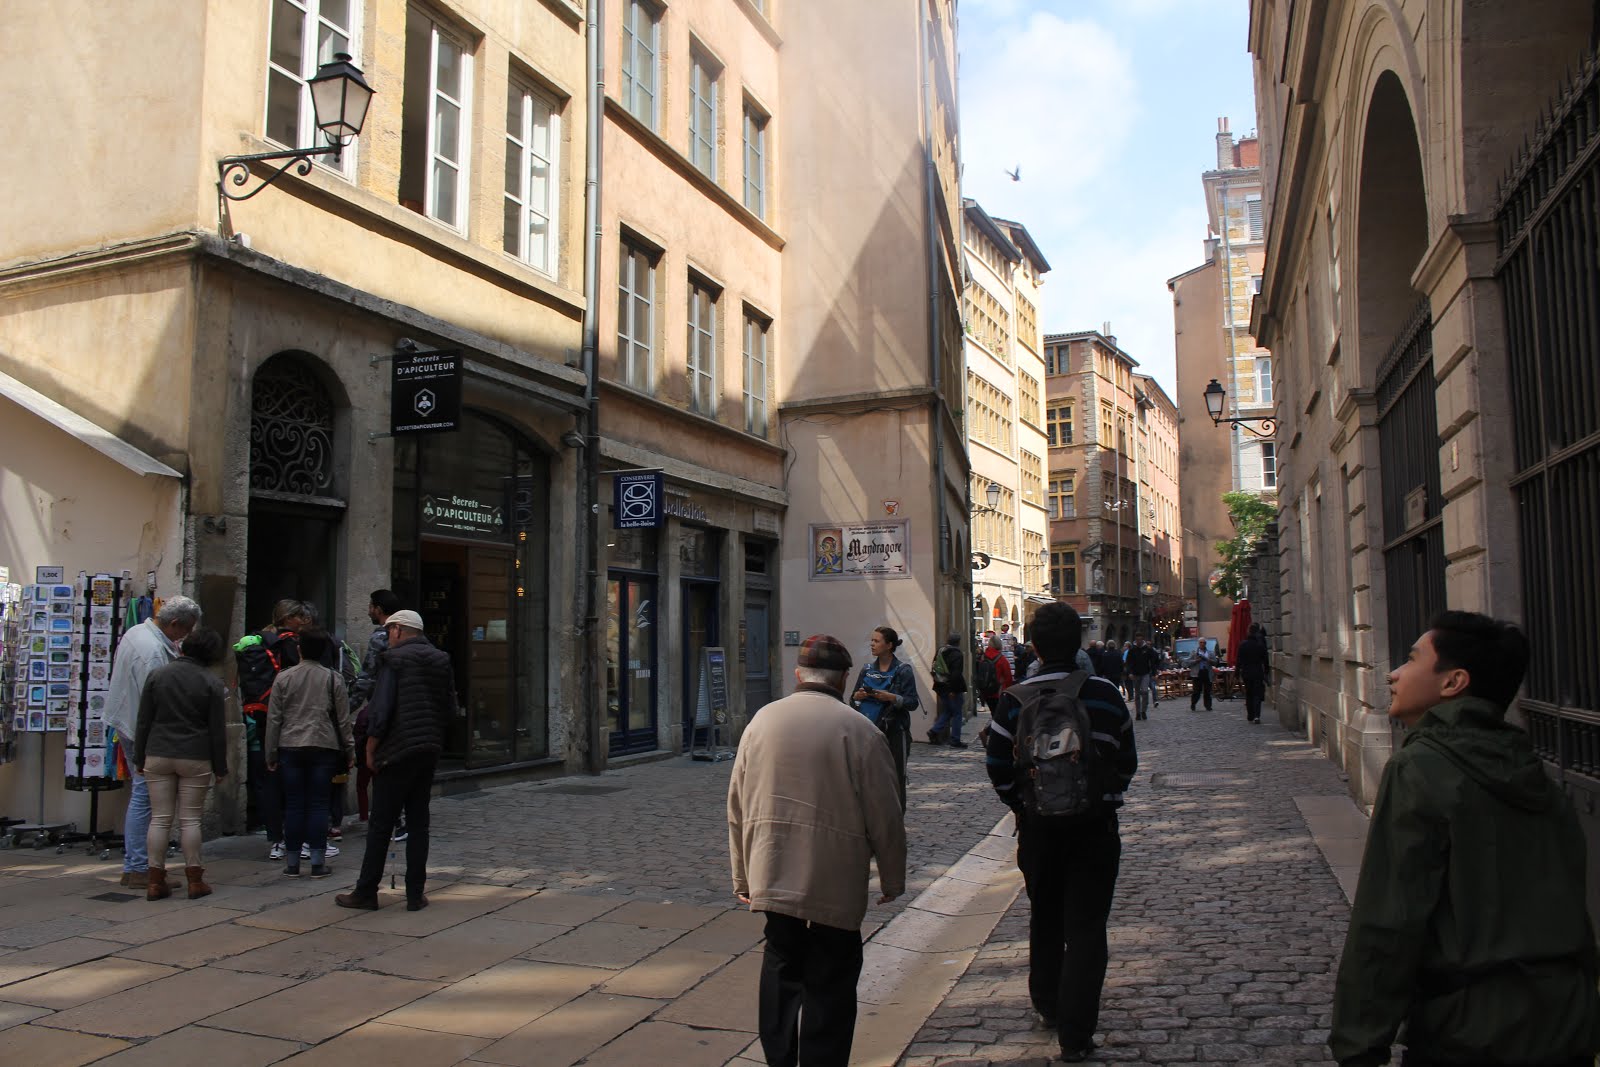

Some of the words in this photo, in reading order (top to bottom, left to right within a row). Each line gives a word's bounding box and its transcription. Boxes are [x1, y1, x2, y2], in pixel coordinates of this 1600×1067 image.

[412, 355, 440, 363] Secrets
[397, 362, 455, 375] D'APICULTEUR
[452, 495, 479, 508] Secrets
[436, 506, 492, 524] D'APICULTEUR
[847, 537, 902, 562] Mandragore
